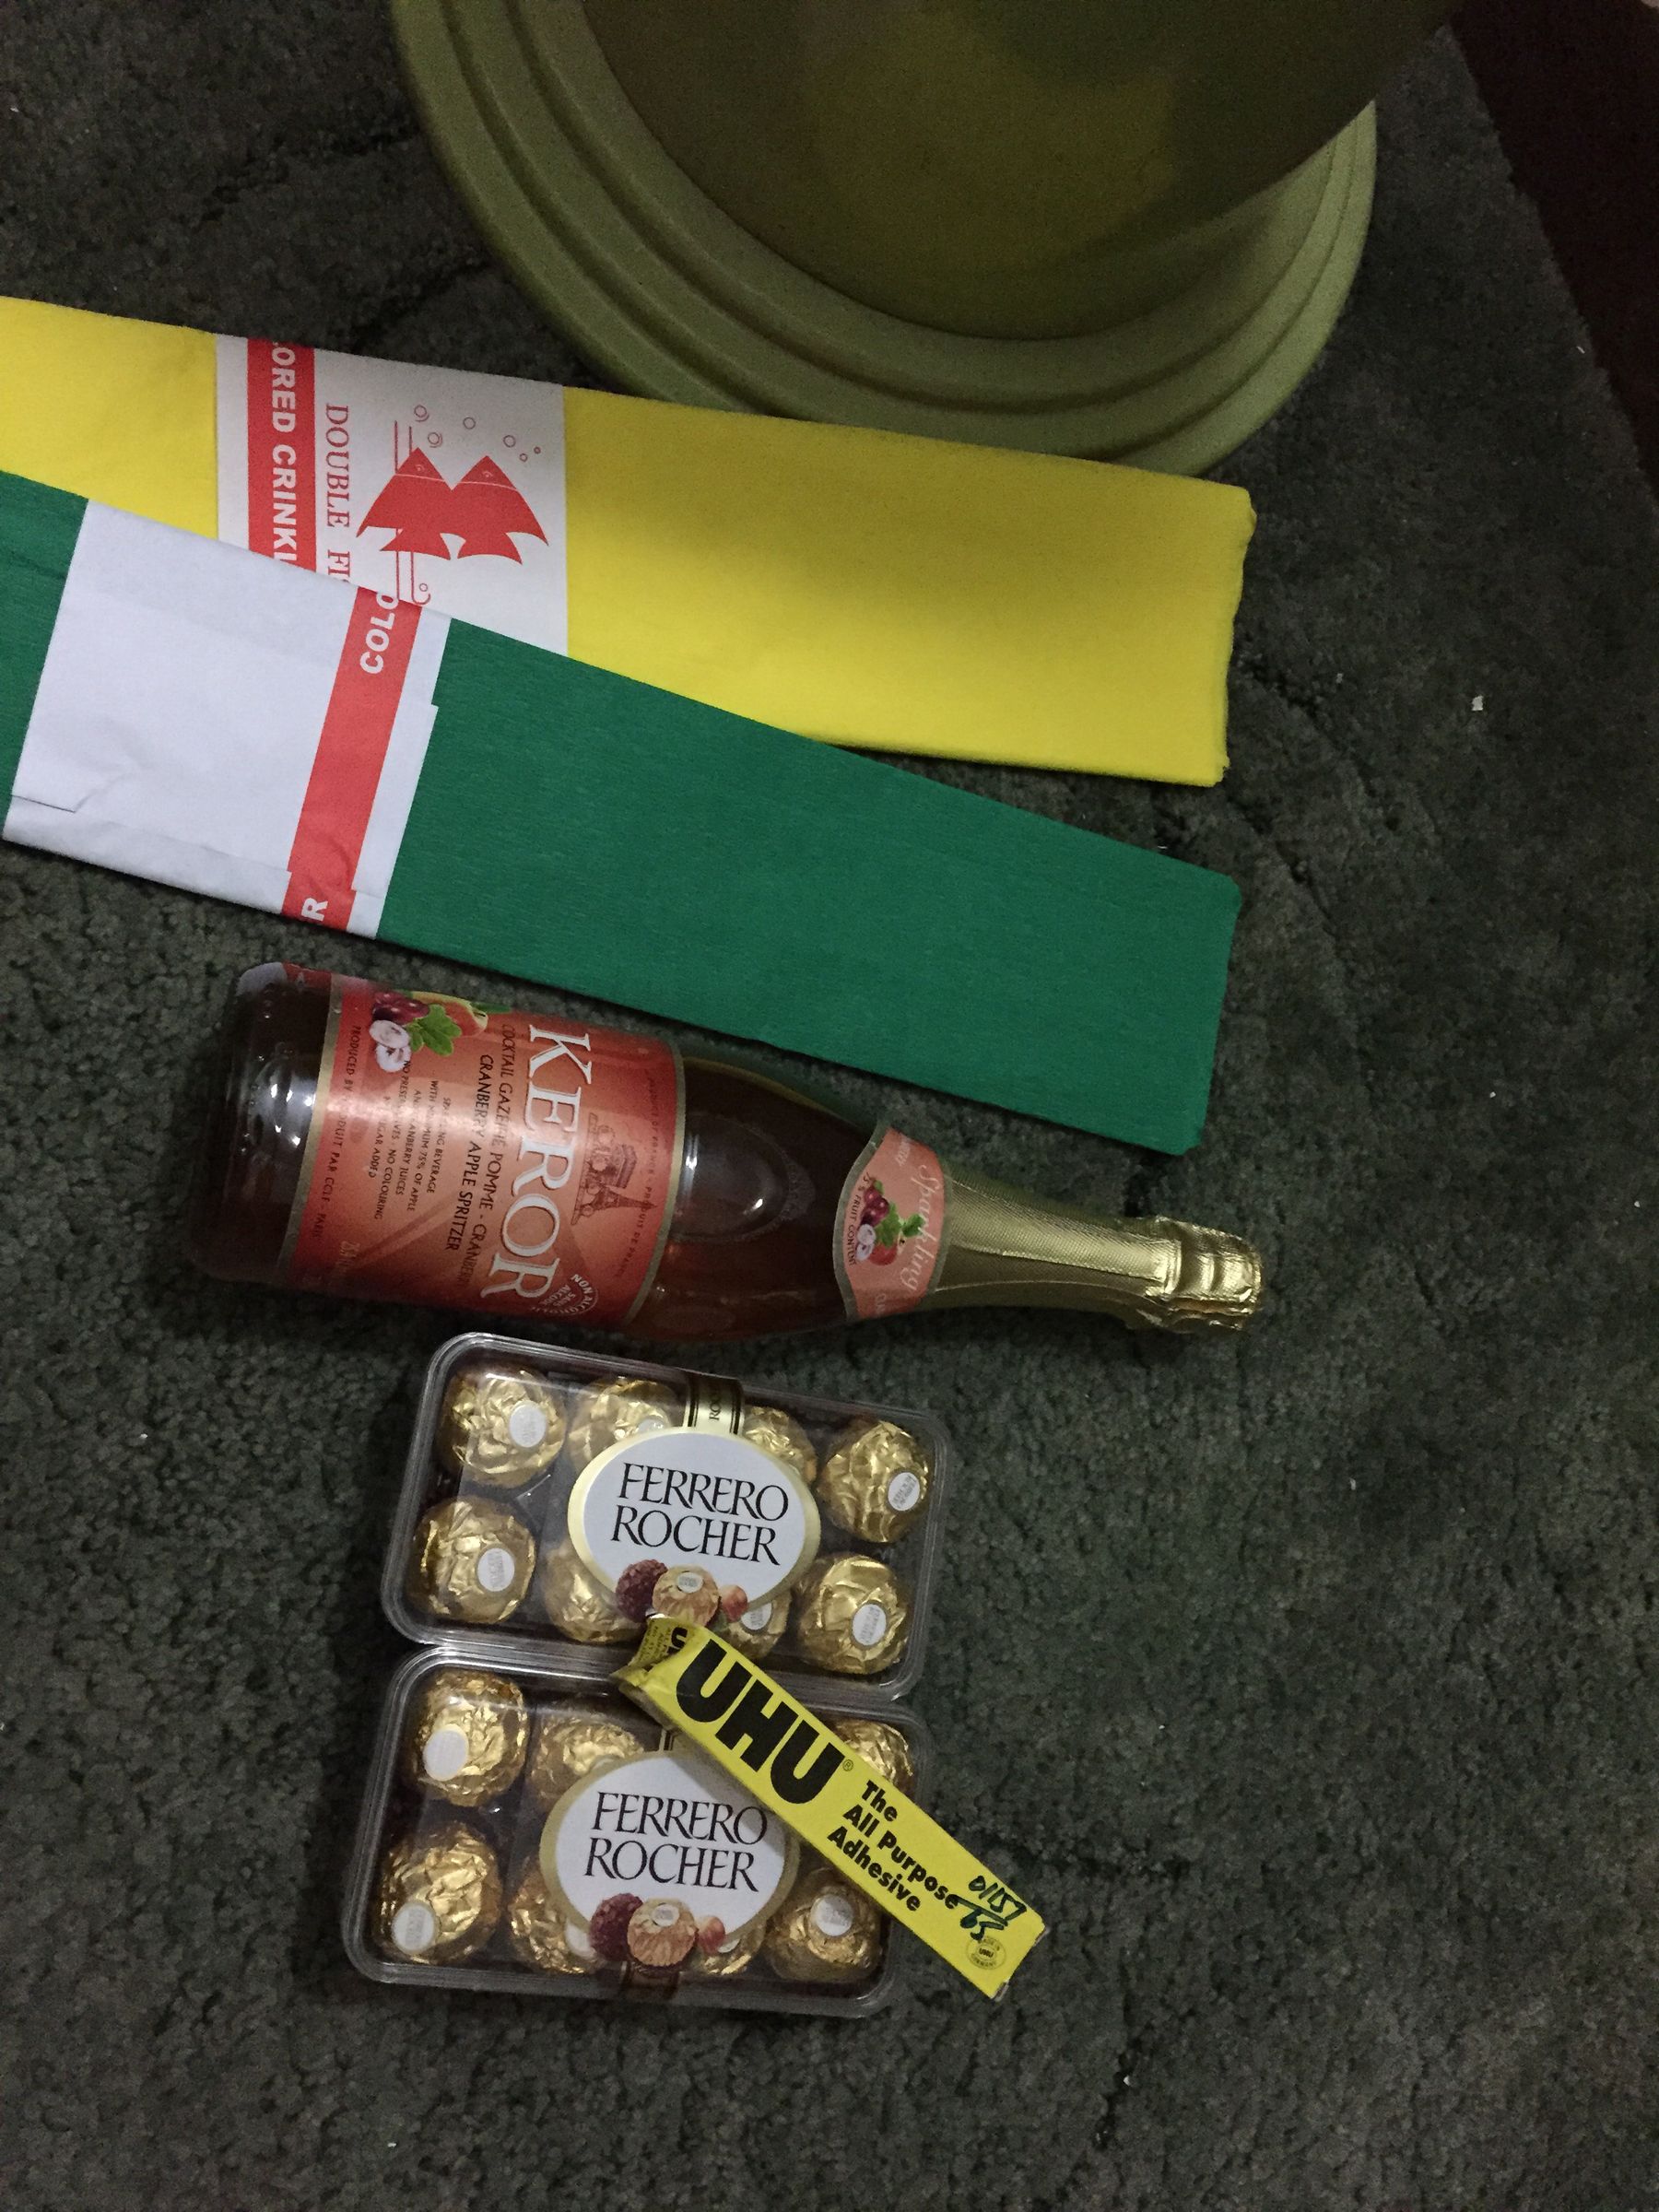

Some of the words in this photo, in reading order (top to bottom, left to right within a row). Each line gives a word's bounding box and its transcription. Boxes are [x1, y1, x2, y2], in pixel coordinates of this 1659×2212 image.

[271, 341, 296, 433] ORED
[325, 403, 350, 528] DOUBLE
[327, 549, 350, 582] FI
[300, 897, 328, 923] R
[347, 1025, 362, 1076] PRODUCED
[402, 1060, 411, 1074] NO
[500, 1024, 516, 1077] COCKTAIL
[429, 1080, 440, 1102] WITH
[471, 1053, 494, 1138] CRANBERRY
[327, 1151, 340, 1172] PAR
[387, 1148, 397, 1165] NO
[395, 1167, 409, 1195] JUICES
[414, 1172, 423, 1186] OF
[426, 1147, 443, 1194] BEVERAGE
[462, 1141, 482, 1187] APPLE
[478, 1152, 503, 1211] POMME
[480, 1024, 593, 1298] KEROR
[373, 1166, 394, 1220] COLOURING
[406, 1186, 418, 1212] APPLE
[849, 1196, 862, 1221] FRUIT
[444, 1190, 473, 1251] SPRITZER
[845, 1224, 858, 1266] CONTENT
[899, 1164, 942, 1291] Sparkling
[571, 1274, 594, 1294] NON
[618, 1462, 789, 1522] FERRERO
[610, 1504, 781, 1566] ROCHER
[676, 1638, 847, 1805] UHU
[592, 1791, 769, 1845] FERRERO
[861, 1780, 900, 1823] The
[583, 1836, 759, 1892] ROCHER
[827, 1825, 924, 1913] Adhesive
[842, 1804, 880, 1840] All
[877, 1830, 963, 1911] Purpose
